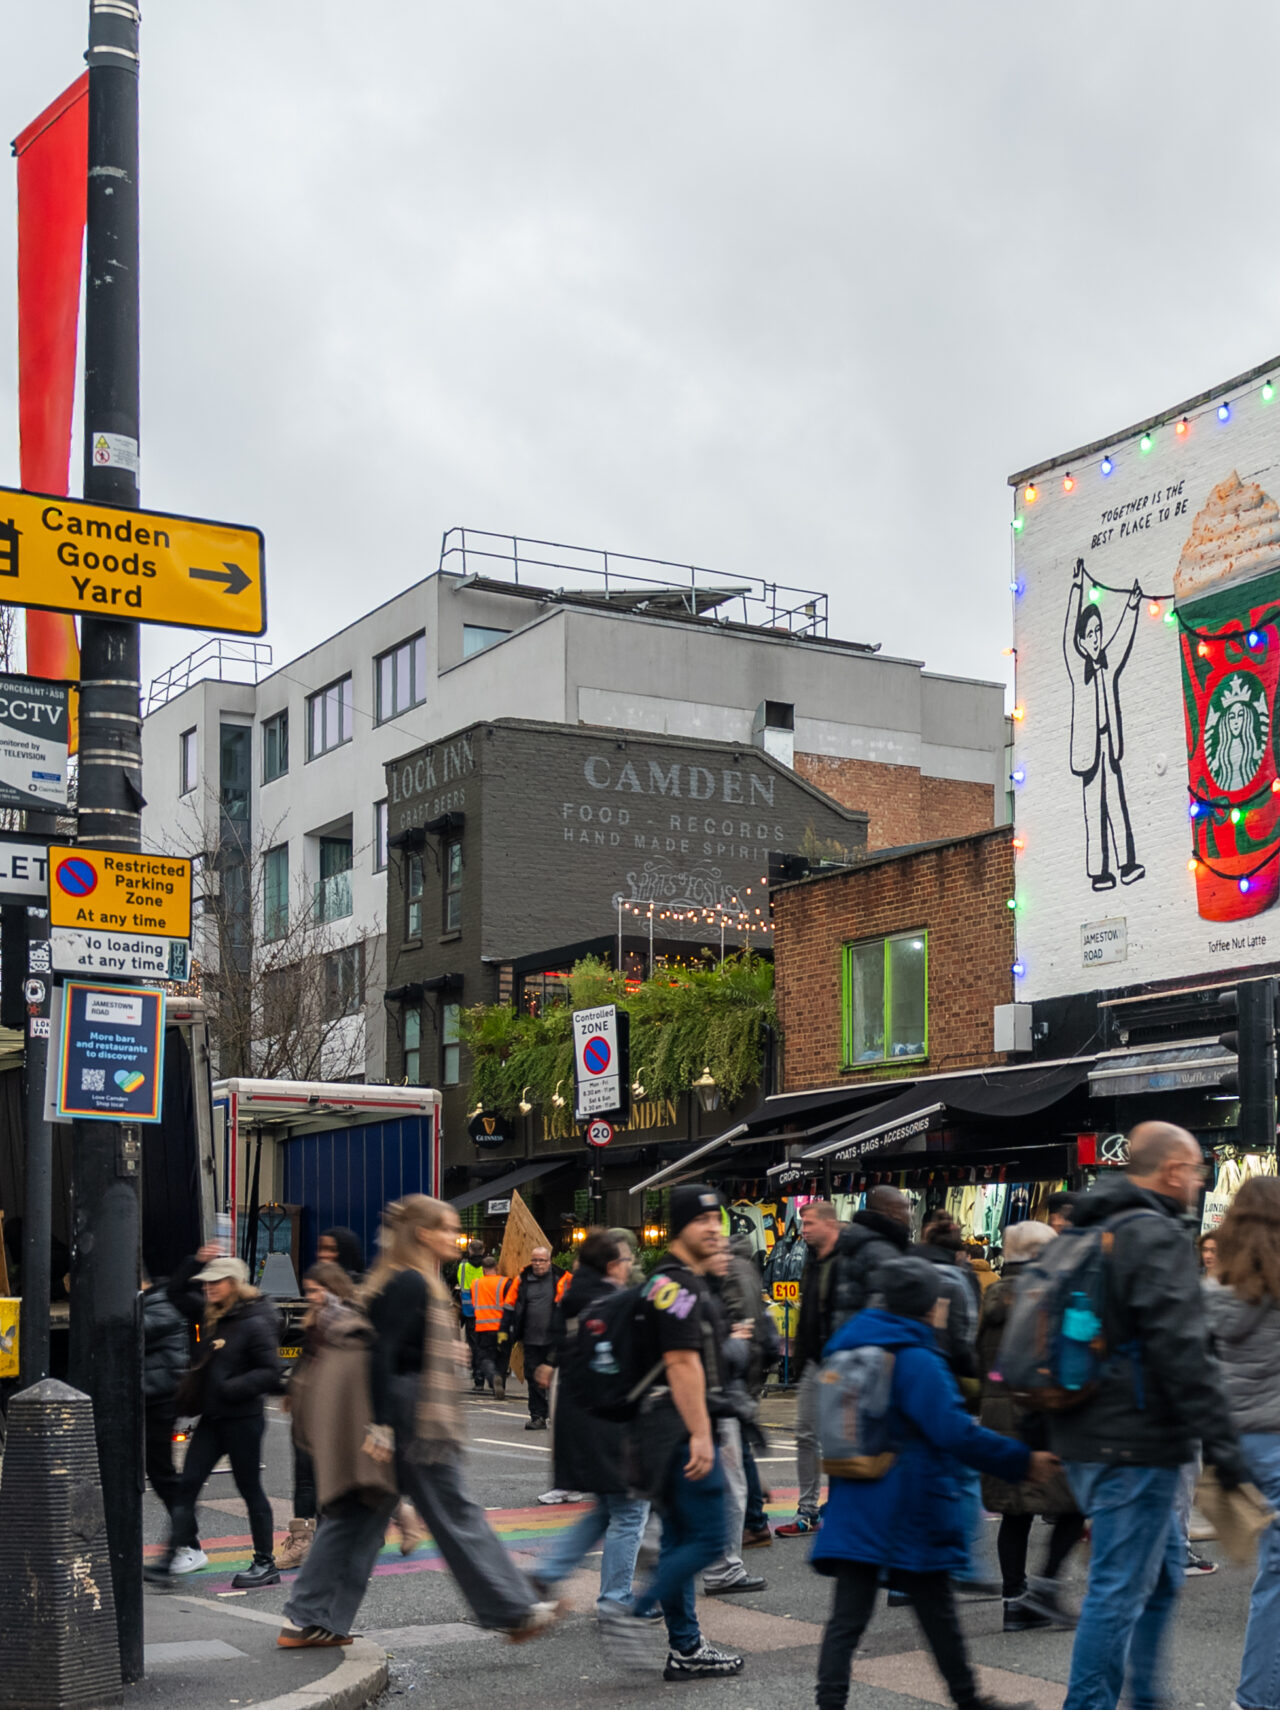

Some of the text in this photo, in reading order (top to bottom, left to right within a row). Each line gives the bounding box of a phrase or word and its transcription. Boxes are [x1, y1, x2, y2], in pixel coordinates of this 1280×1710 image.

[1101, 480, 1185, 525] TOGETHER IS THE
[42, 506, 170, 548] Camden
[1091, 499, 1189, 549] BEST PLACE TO BE
[57, 542, 157, 579] Goods
[71, 576, 142, 608] Yard
[31, 742, 40, 751] by
[4, 749, 46, 761] TELEVISION
[392, 738, 475, 804] LOCK INN
[583, 756, 777, 808] CAMDEN
[433, 788, 465, 815] BEERS
[562, 803, 631, 825] FOOD
[670, 815, 785, 842] RECORDS
[563, 828, 784, 860] HAND MADE SPIRIT
[105, 857, 185, 878] Restricted
[115, 875, 174, 895] Parking
[126, 892, 163, 908] Zone
[76, 908, 167, 929] At any time
[1083, 929, 1124, 946] JAMESTOW
[1208, 935, 1267, 954] Toffee Nut Latte
[108, 938, 163, 958] loading
[1083, 949, 1104, 961] ROAD
[99, 956, 126, 971] any
[132, 956, 165, 972] time
[91, 1000, 133, 1011] JAMESTOWN
[91, 1008, 110, 1016] ROAD
[575, 1008, 614, 1023] Controlled
[581, 1021, 609, 1035] ZONE
[90, 1032, 136, 1044] More bars
[76, 1040, 148, 1054] and restaurants
[86, 1050, 138, 1061] to discover
[96, 1100, 124, 1108] Shop local
[106, 1094, 128, 1102] Camden
[475, 1134, 504, 1142] GUINNESS
[592, 1127, 610, 1139] 20
[861, 1138, 879, 1155] BAGS
[883, 1117, 930, 1145] ACCESSORIES
[779, 1170, 800, 1185] CROPS
[776, 1284, 796, 1297] £10
